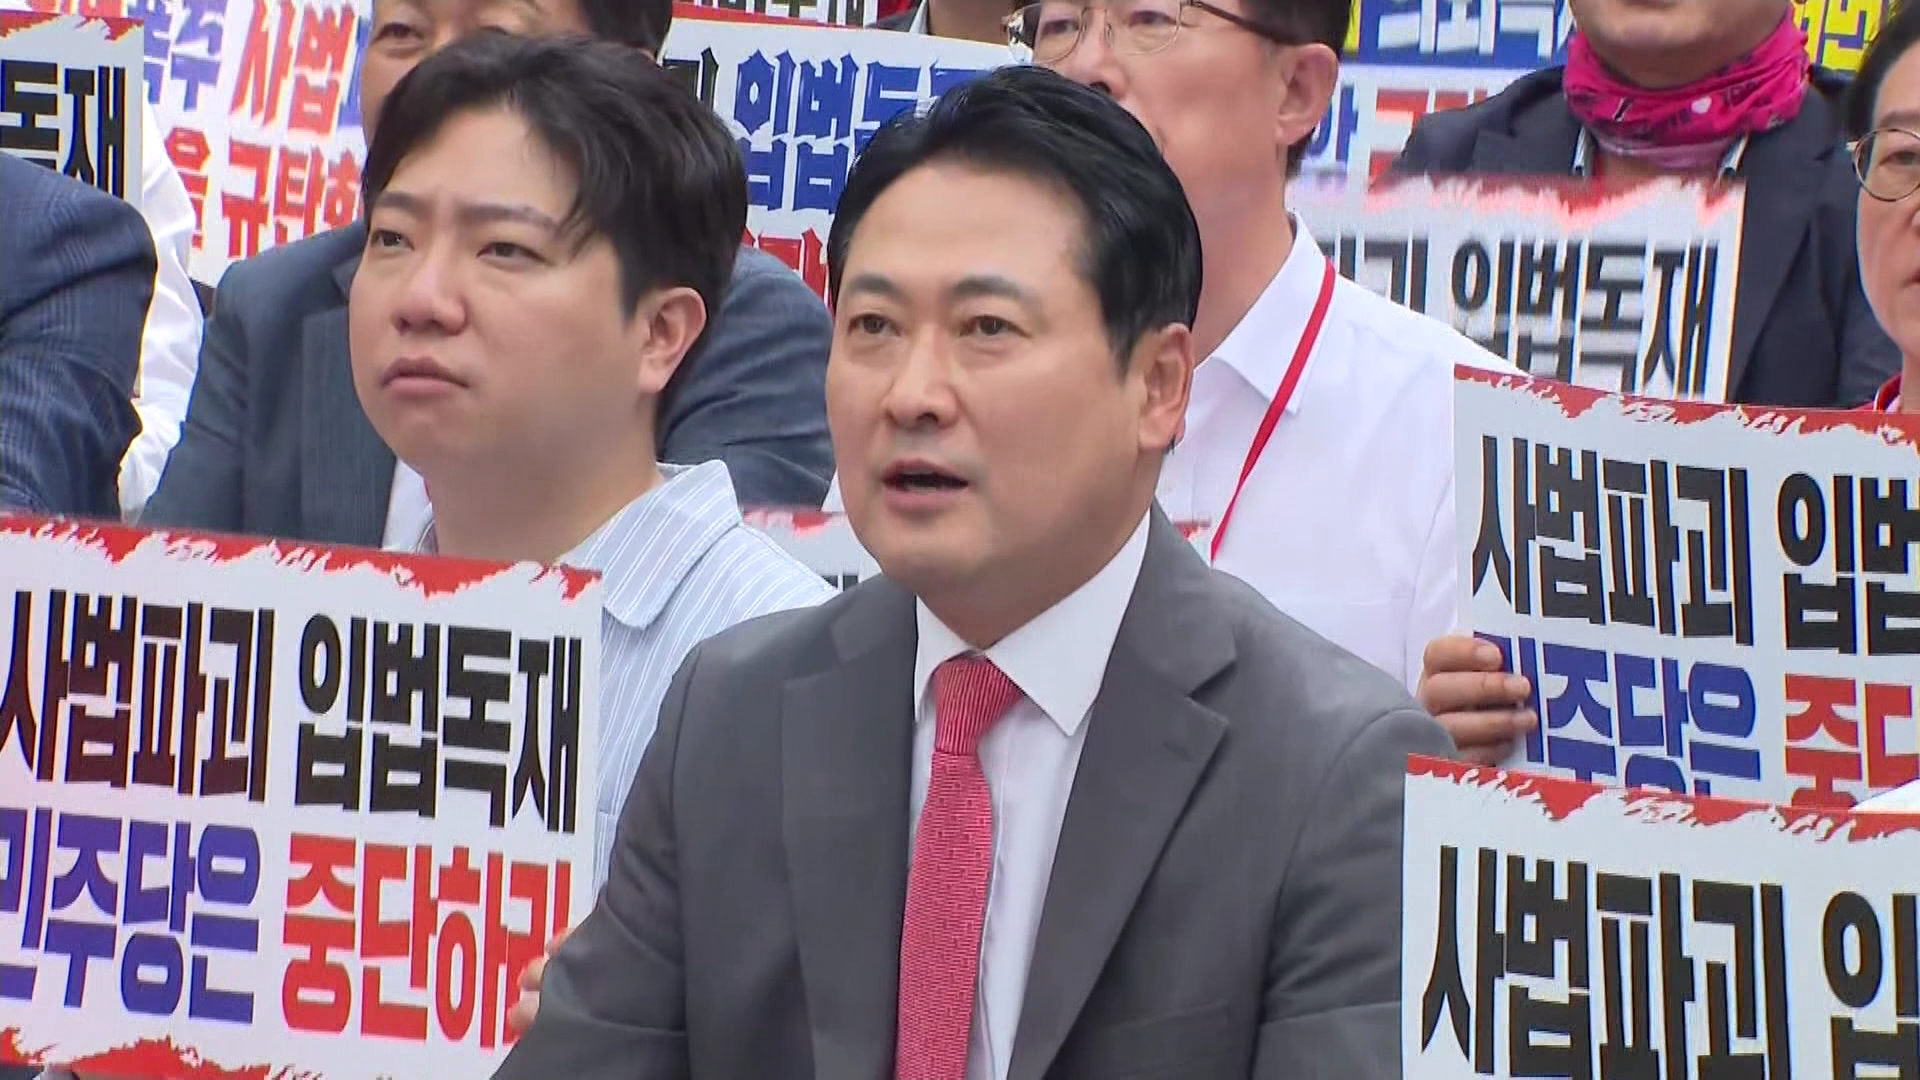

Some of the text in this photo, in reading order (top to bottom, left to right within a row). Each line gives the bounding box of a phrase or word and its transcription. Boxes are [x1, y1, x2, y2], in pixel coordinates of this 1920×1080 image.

[229, 0, 367, 135] 사법
[1472, 435, 1754, 646] 사법파괴
[0, 590, 583, 835] 사법파괴 입법독재
[1422, 845, 1793, 1080] 사법파괴
